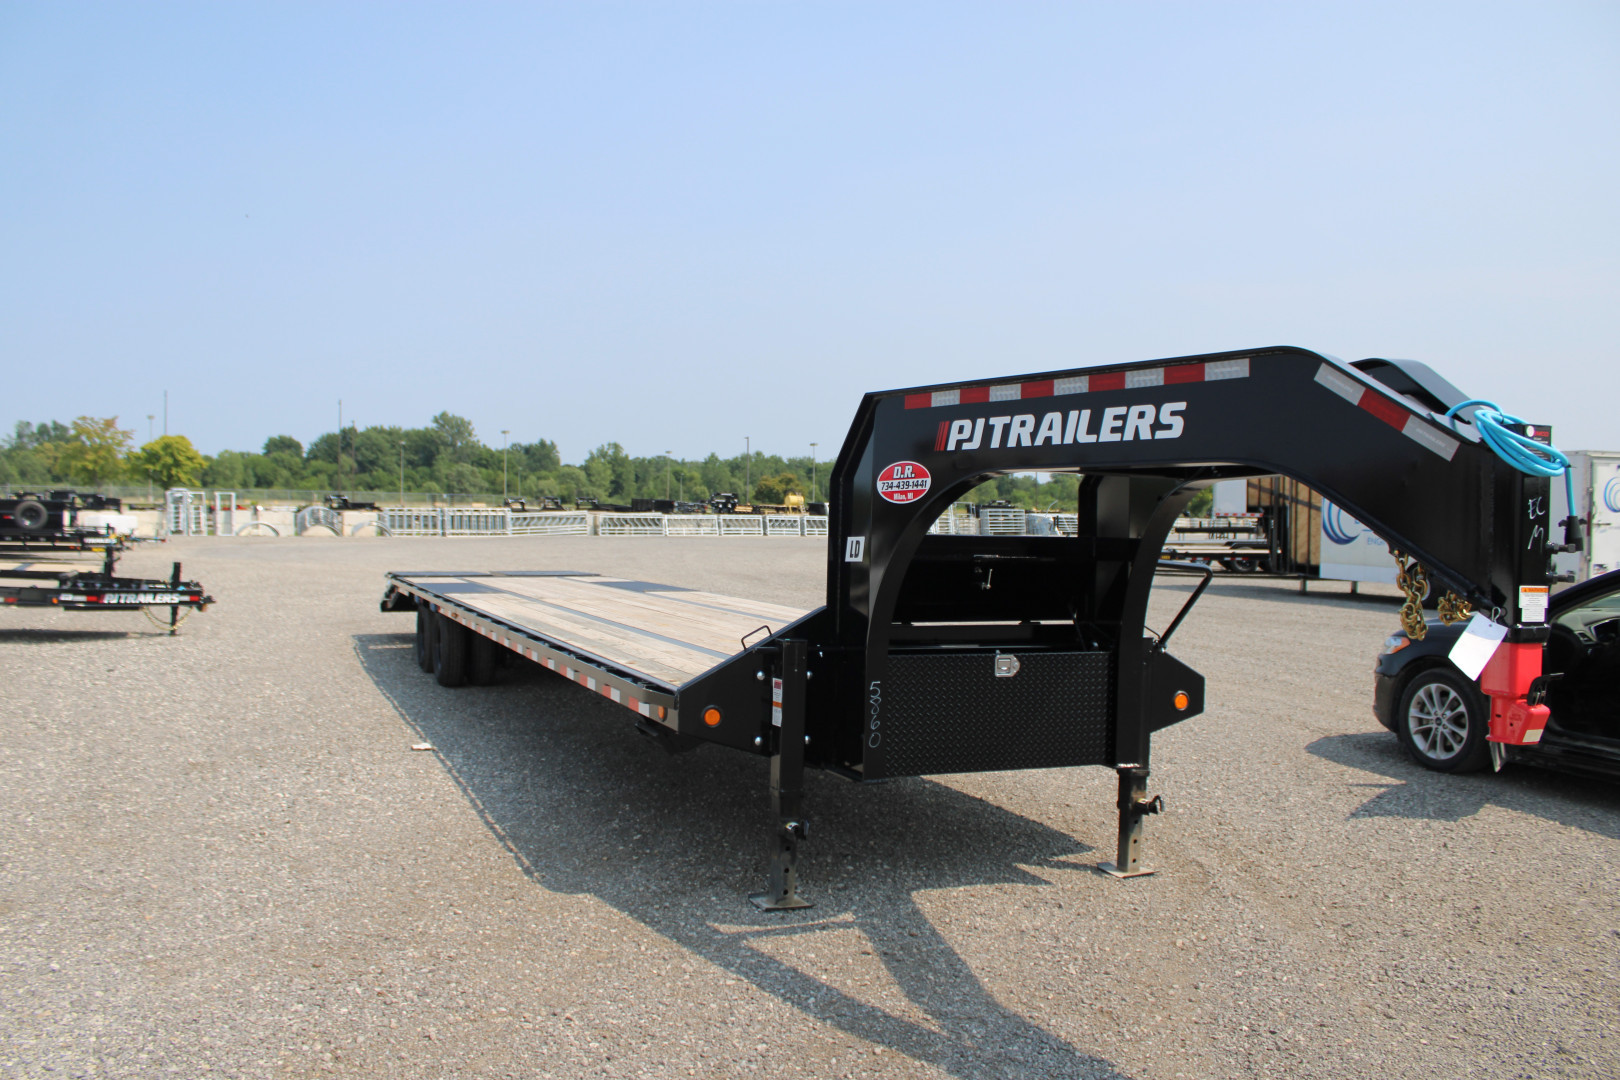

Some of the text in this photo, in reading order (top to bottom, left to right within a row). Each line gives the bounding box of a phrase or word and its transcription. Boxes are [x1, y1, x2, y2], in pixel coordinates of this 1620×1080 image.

[947, 401, 1187, 451] PJ TRAILERS
[893, 465, 915, 479] D.R.
[881, 480, 928, 491] 734-439-1441
[850, 540, 861, 558] LD
[118, 593, 180, 604] TRAILERS
